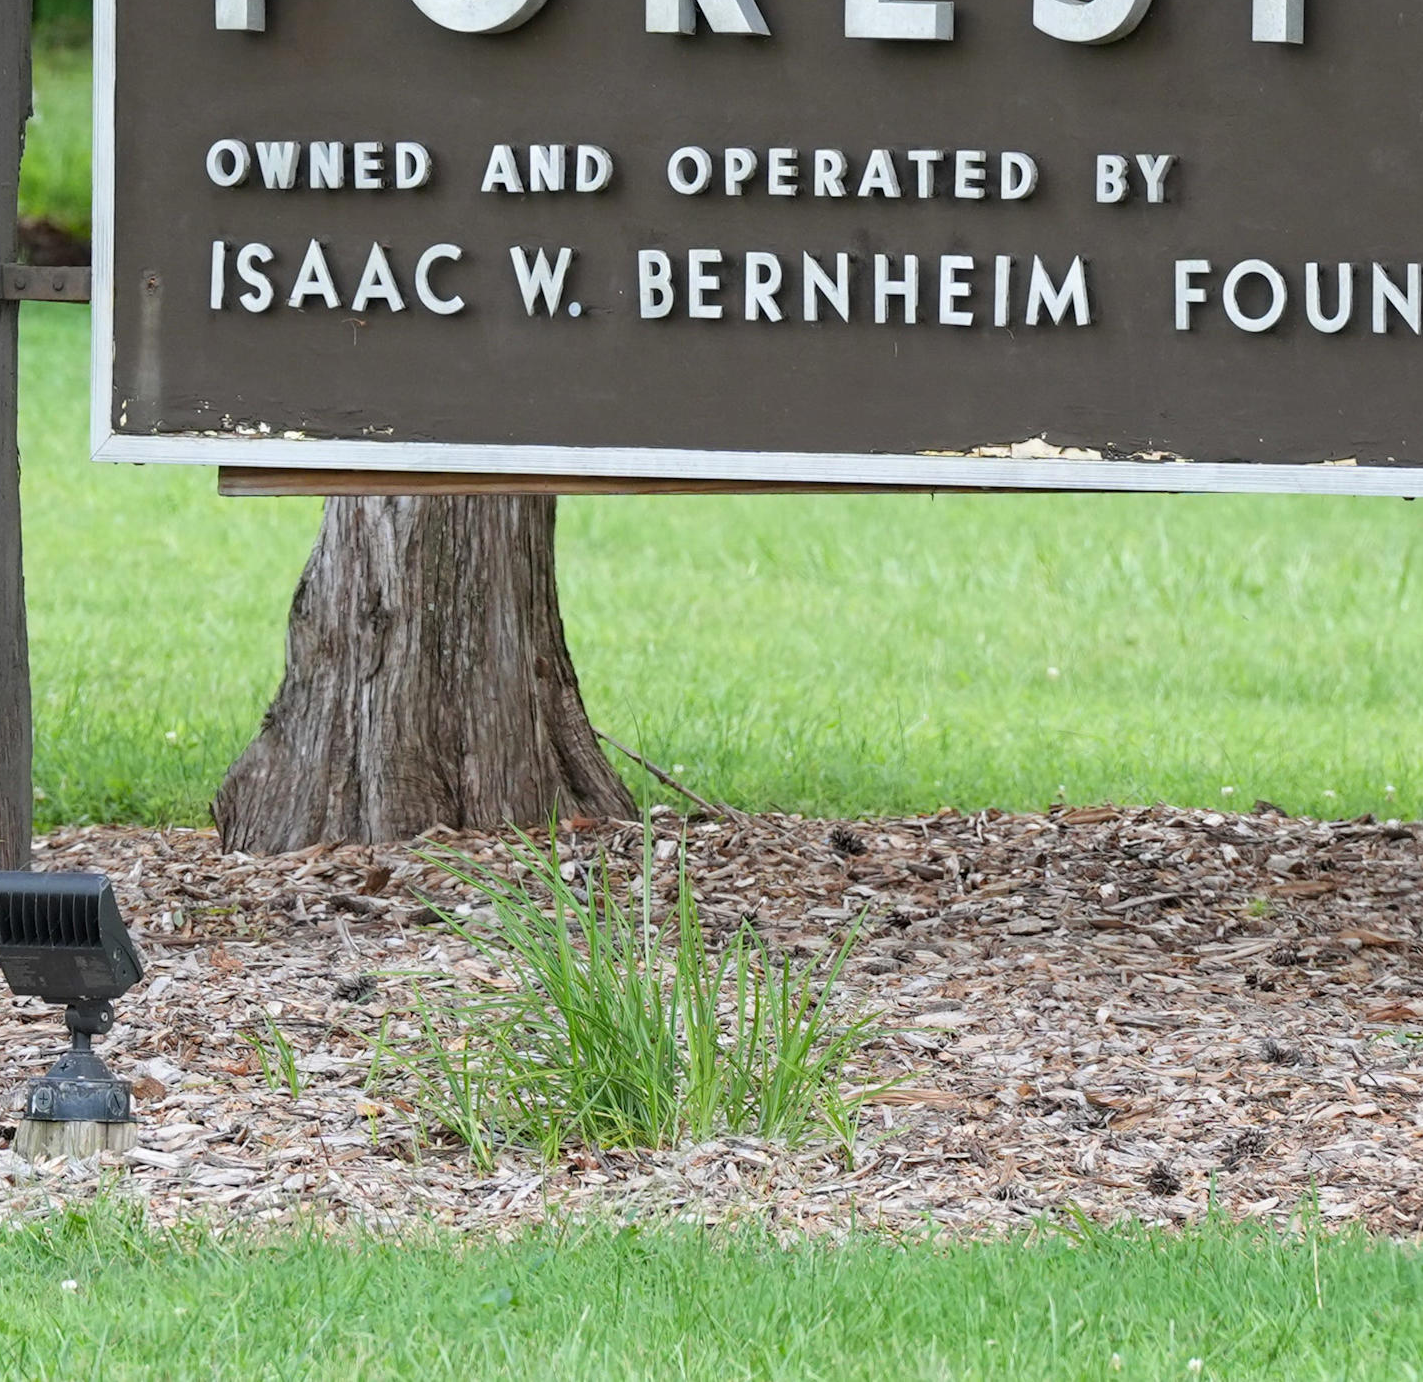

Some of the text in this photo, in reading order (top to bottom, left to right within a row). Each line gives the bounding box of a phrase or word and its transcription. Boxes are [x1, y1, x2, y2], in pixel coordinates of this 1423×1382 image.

[205, 138, 1174, 204] OWNED AND OPERATED BY
[210, 237, 466, 316] ISAAC
[508, 245, 583, 319] W.
[637, 248, 1091, 329] BERNHEIM
